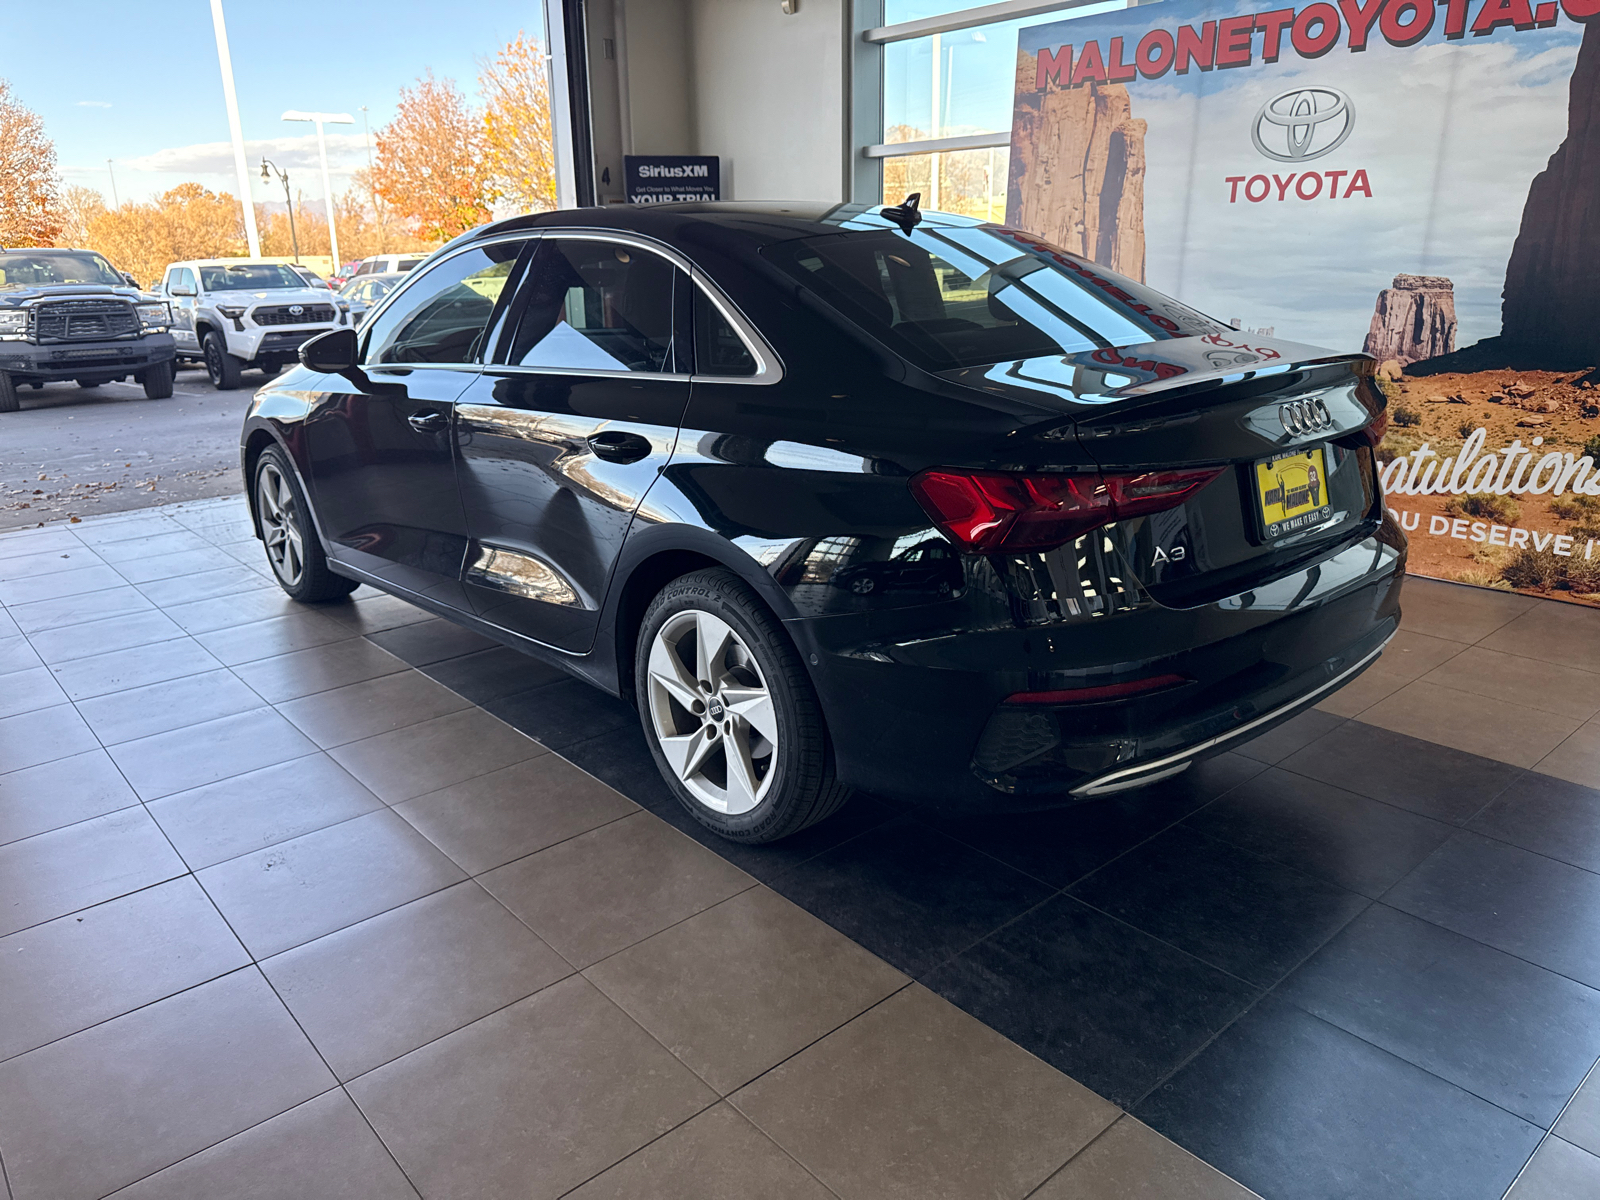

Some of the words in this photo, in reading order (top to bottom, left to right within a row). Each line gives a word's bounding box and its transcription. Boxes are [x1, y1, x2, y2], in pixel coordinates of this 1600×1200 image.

[638, 165, 708, 178] SiriusXM
[1225, 168, 1373, 203] TOYOTA
[1309, 471, 1316, 482] 32
[1282, 521, 1290, 532] WE
[1291, 517, 1303, 529] MAKE
[1303, 515, 1308, 525] IT
[1308, 511, 1319, 522] EASY
[1429, 515, 1575, 557] DESERVE
[1151, 546, 1185, 567] A3
[667, 586, 711, 601] CONTROL
[713, 594, 722, 603] 2
